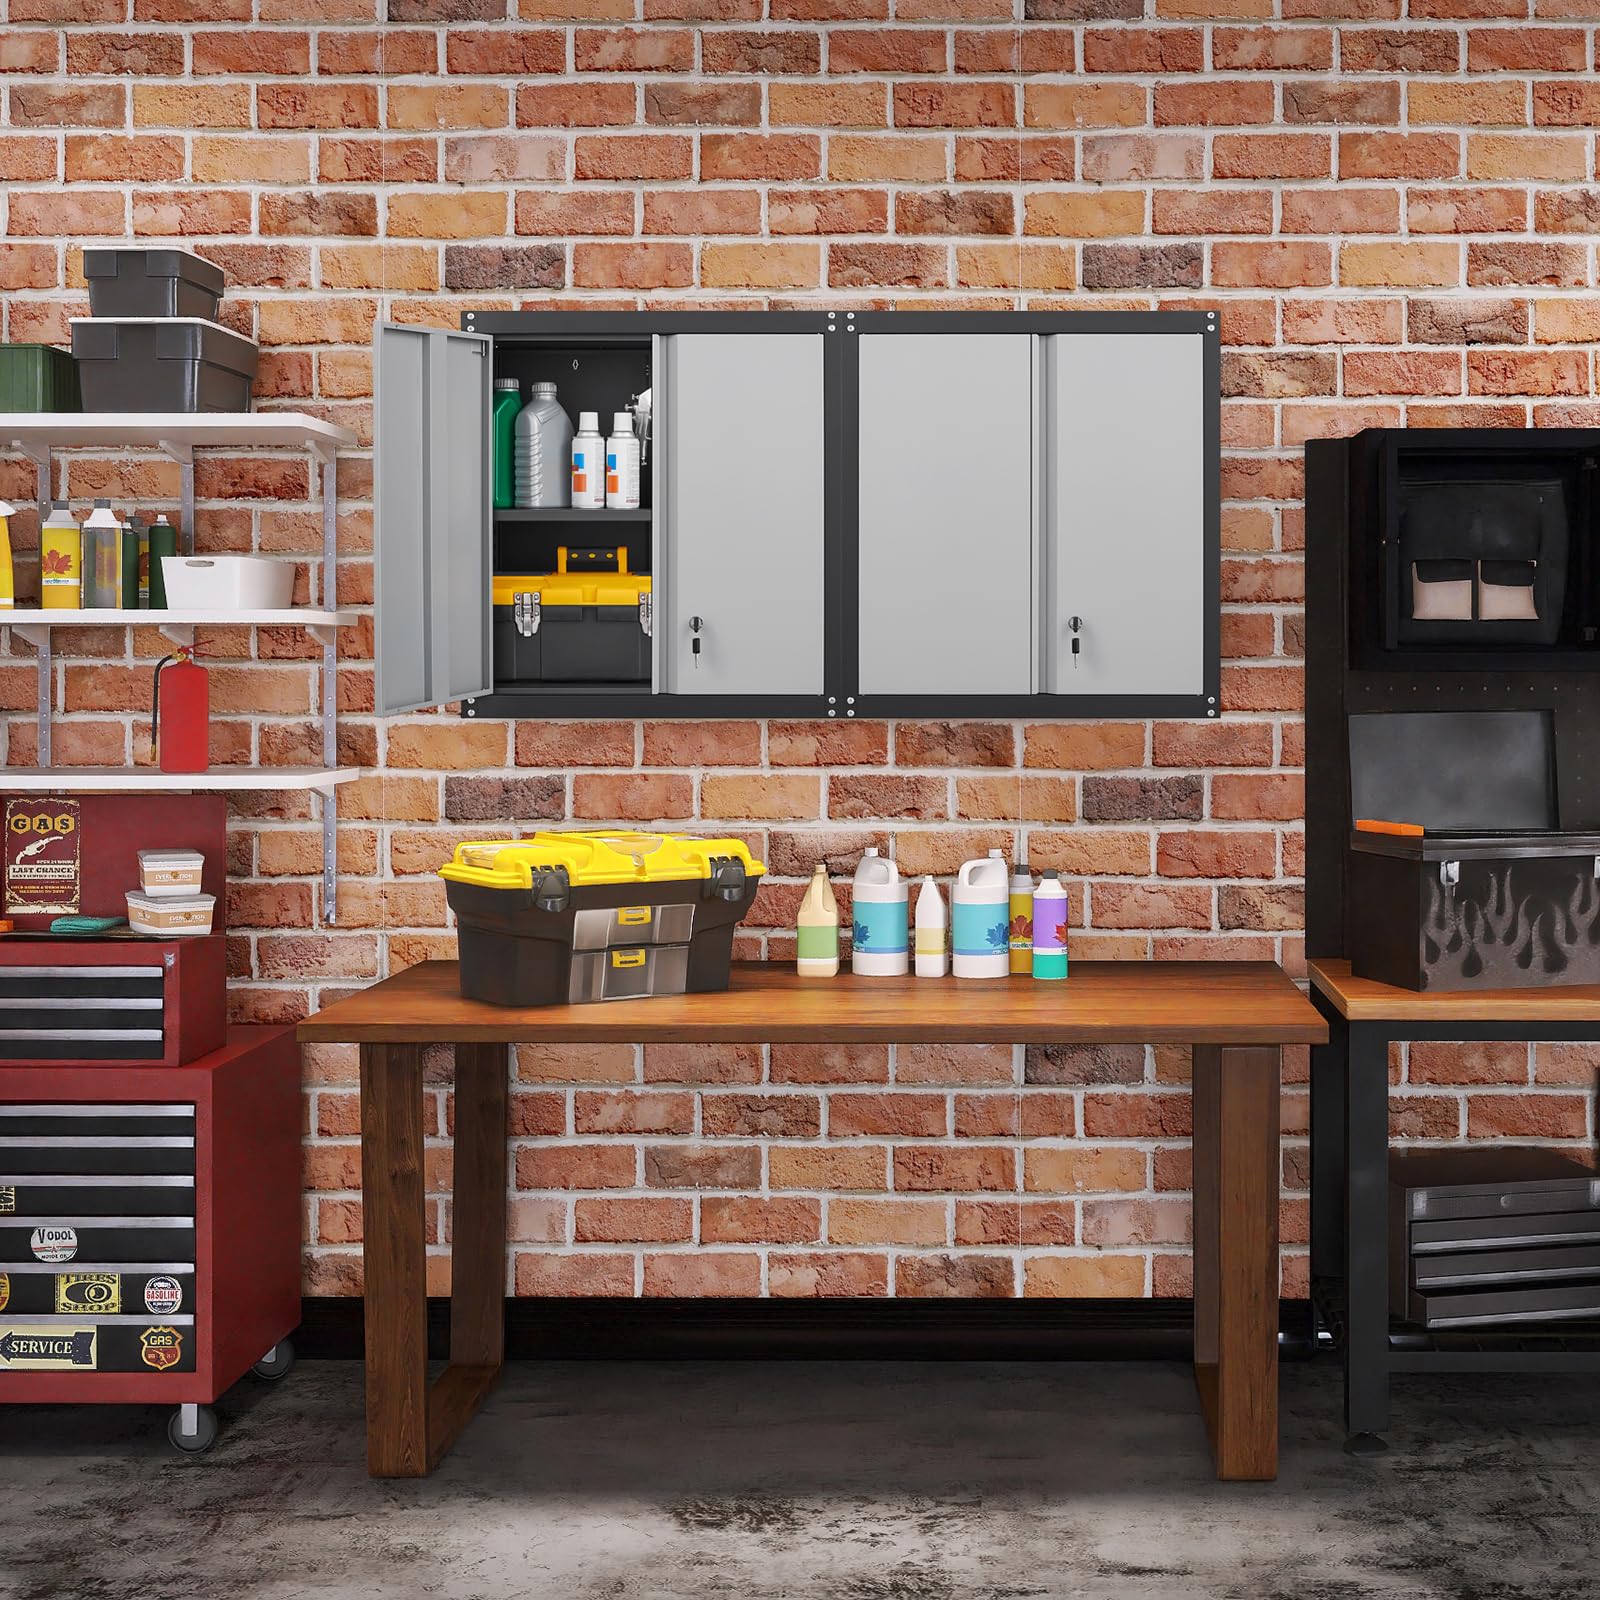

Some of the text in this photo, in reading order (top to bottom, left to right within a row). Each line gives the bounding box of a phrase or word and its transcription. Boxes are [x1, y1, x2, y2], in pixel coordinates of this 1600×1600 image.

[13, 818, 70, 830] GAS
[38, 1228, 73, 1244] VODOL
[61, 1273, 117, 1285] TIRES
[146, 1290, 180, 1301] GASOLINE
[60, 1302, 117, 1312] SHOP
[150, 1335, 173, 1346] GAS
[10, 1340, 73, 1354] SERVICE
